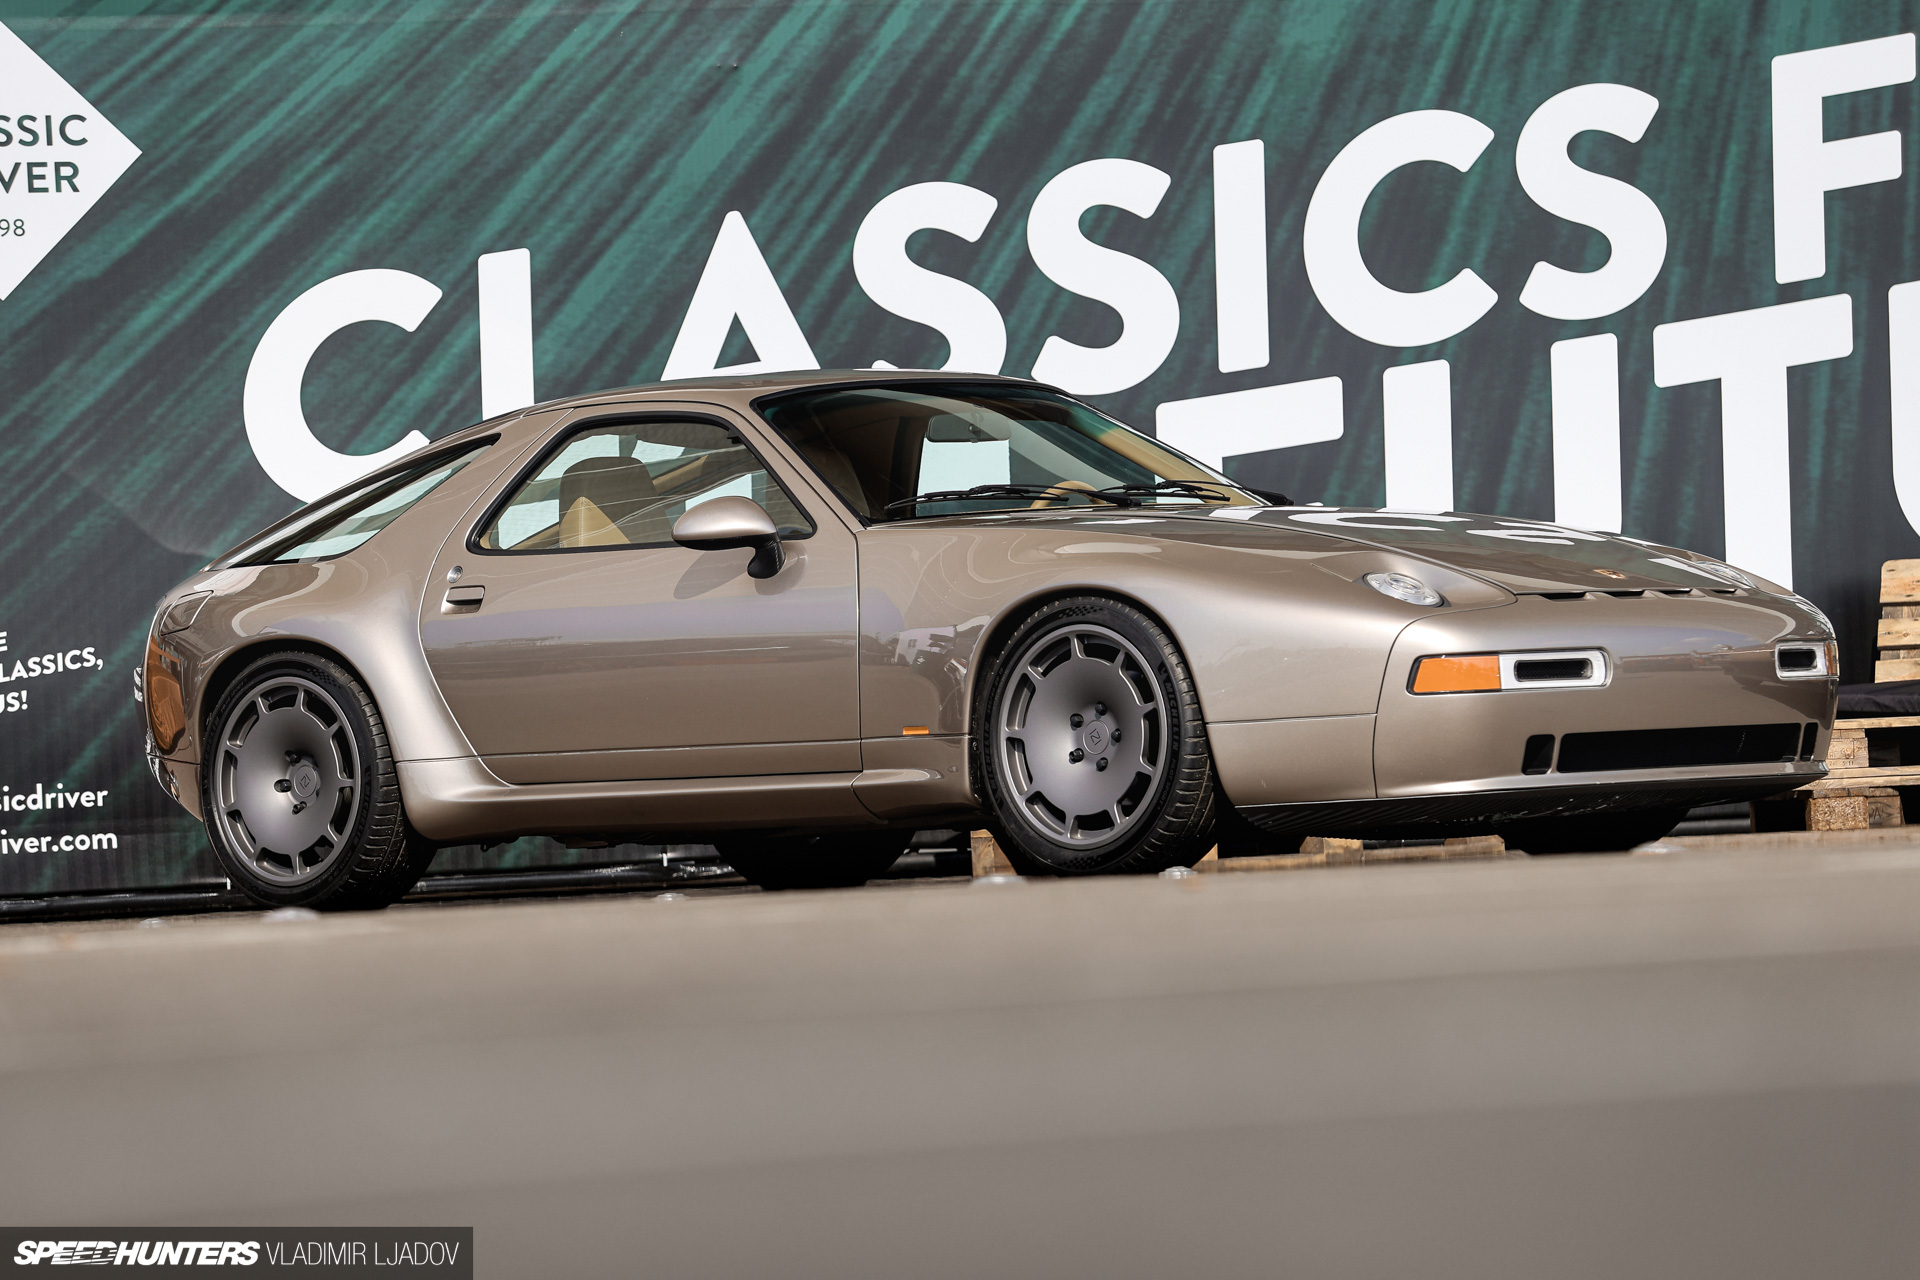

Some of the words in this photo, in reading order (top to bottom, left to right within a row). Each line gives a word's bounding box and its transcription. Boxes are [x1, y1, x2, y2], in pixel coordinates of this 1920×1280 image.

[0, 218, 25, 237] 98
[1165, 682, 1179, 752] MICHELIN
[1168, 758, 1177, 780] PILOT
[0, 782, 108, 812] icdriver
[0, 828, 118, 855] iver.com
